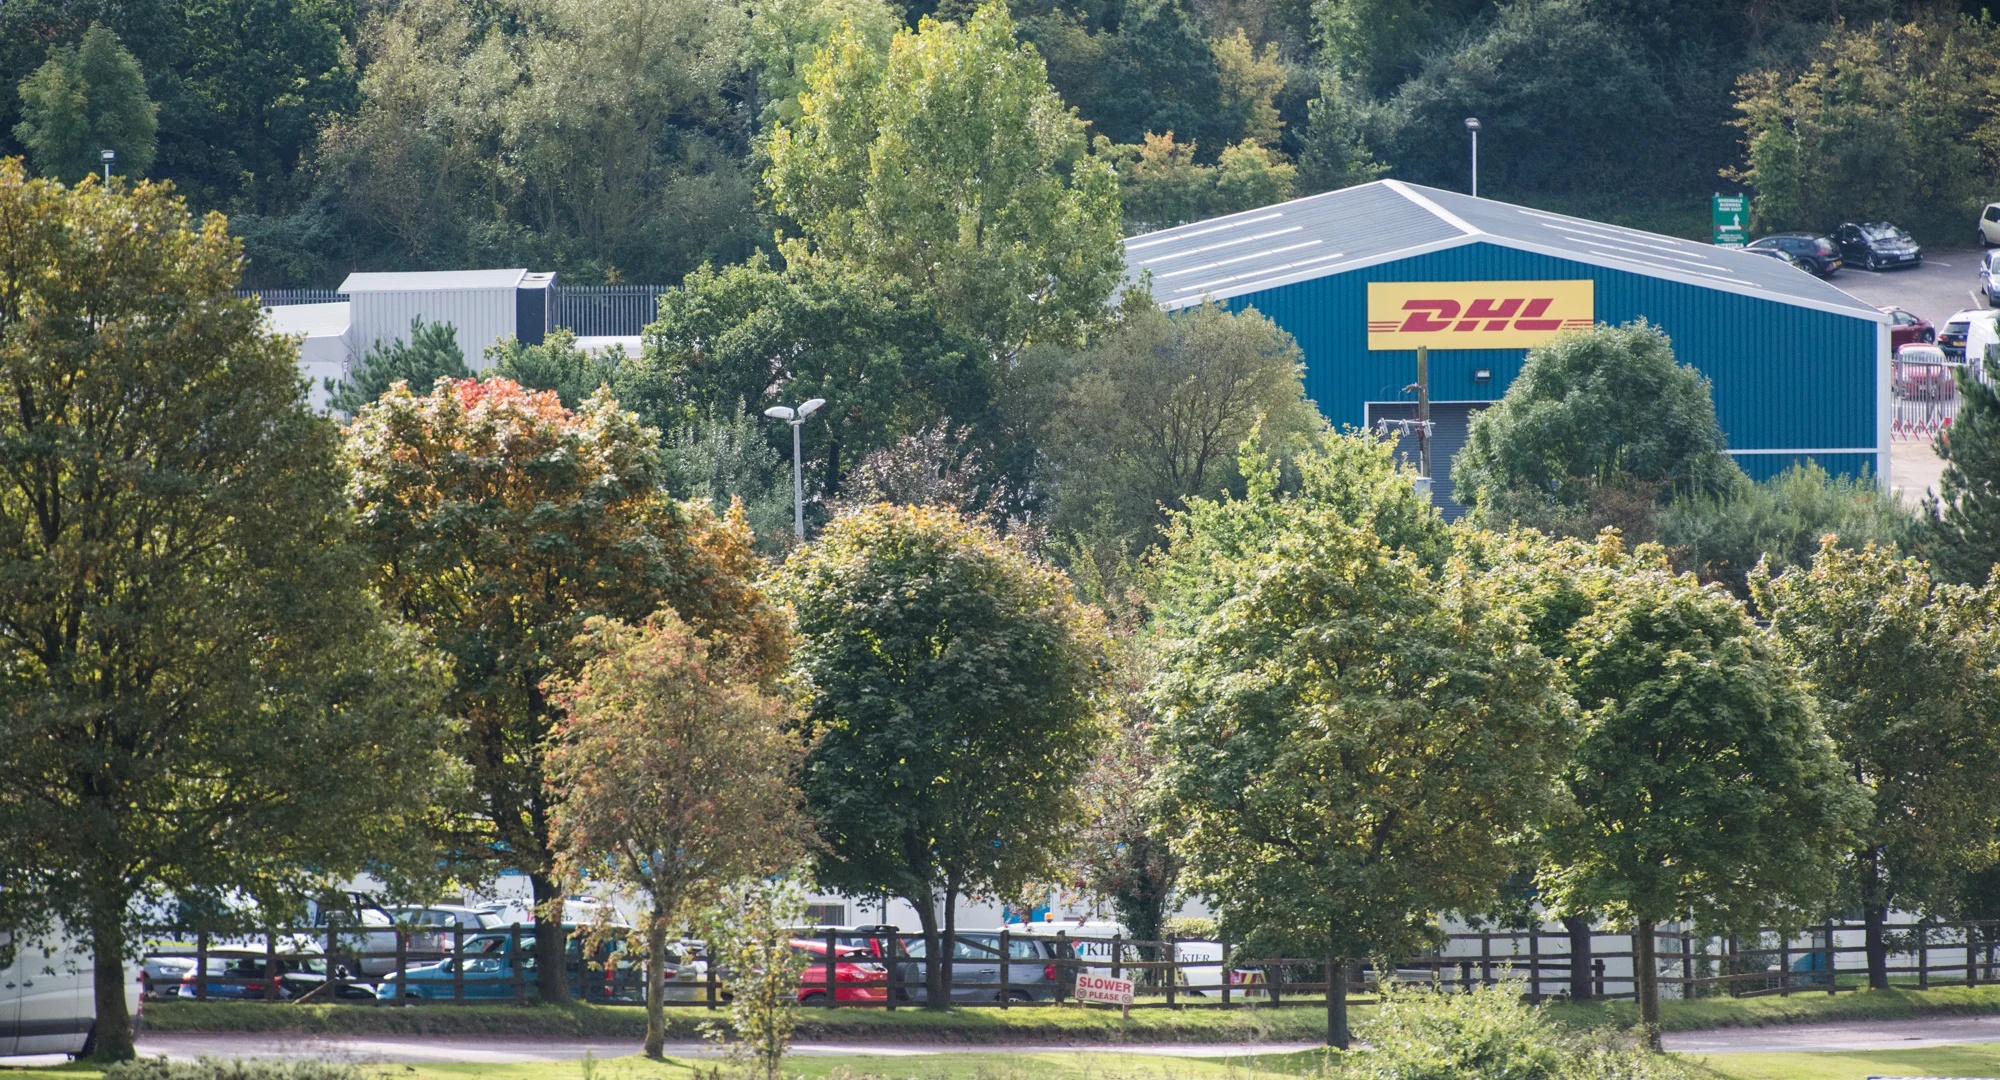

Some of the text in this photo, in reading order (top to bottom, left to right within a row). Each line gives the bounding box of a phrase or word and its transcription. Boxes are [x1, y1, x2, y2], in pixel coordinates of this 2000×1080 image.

[1398, 298, 1564, 332] DHL
[1079, 976, 1131, 993] SLOWER
[1089, 991, 1119, 1001] PLEASE
